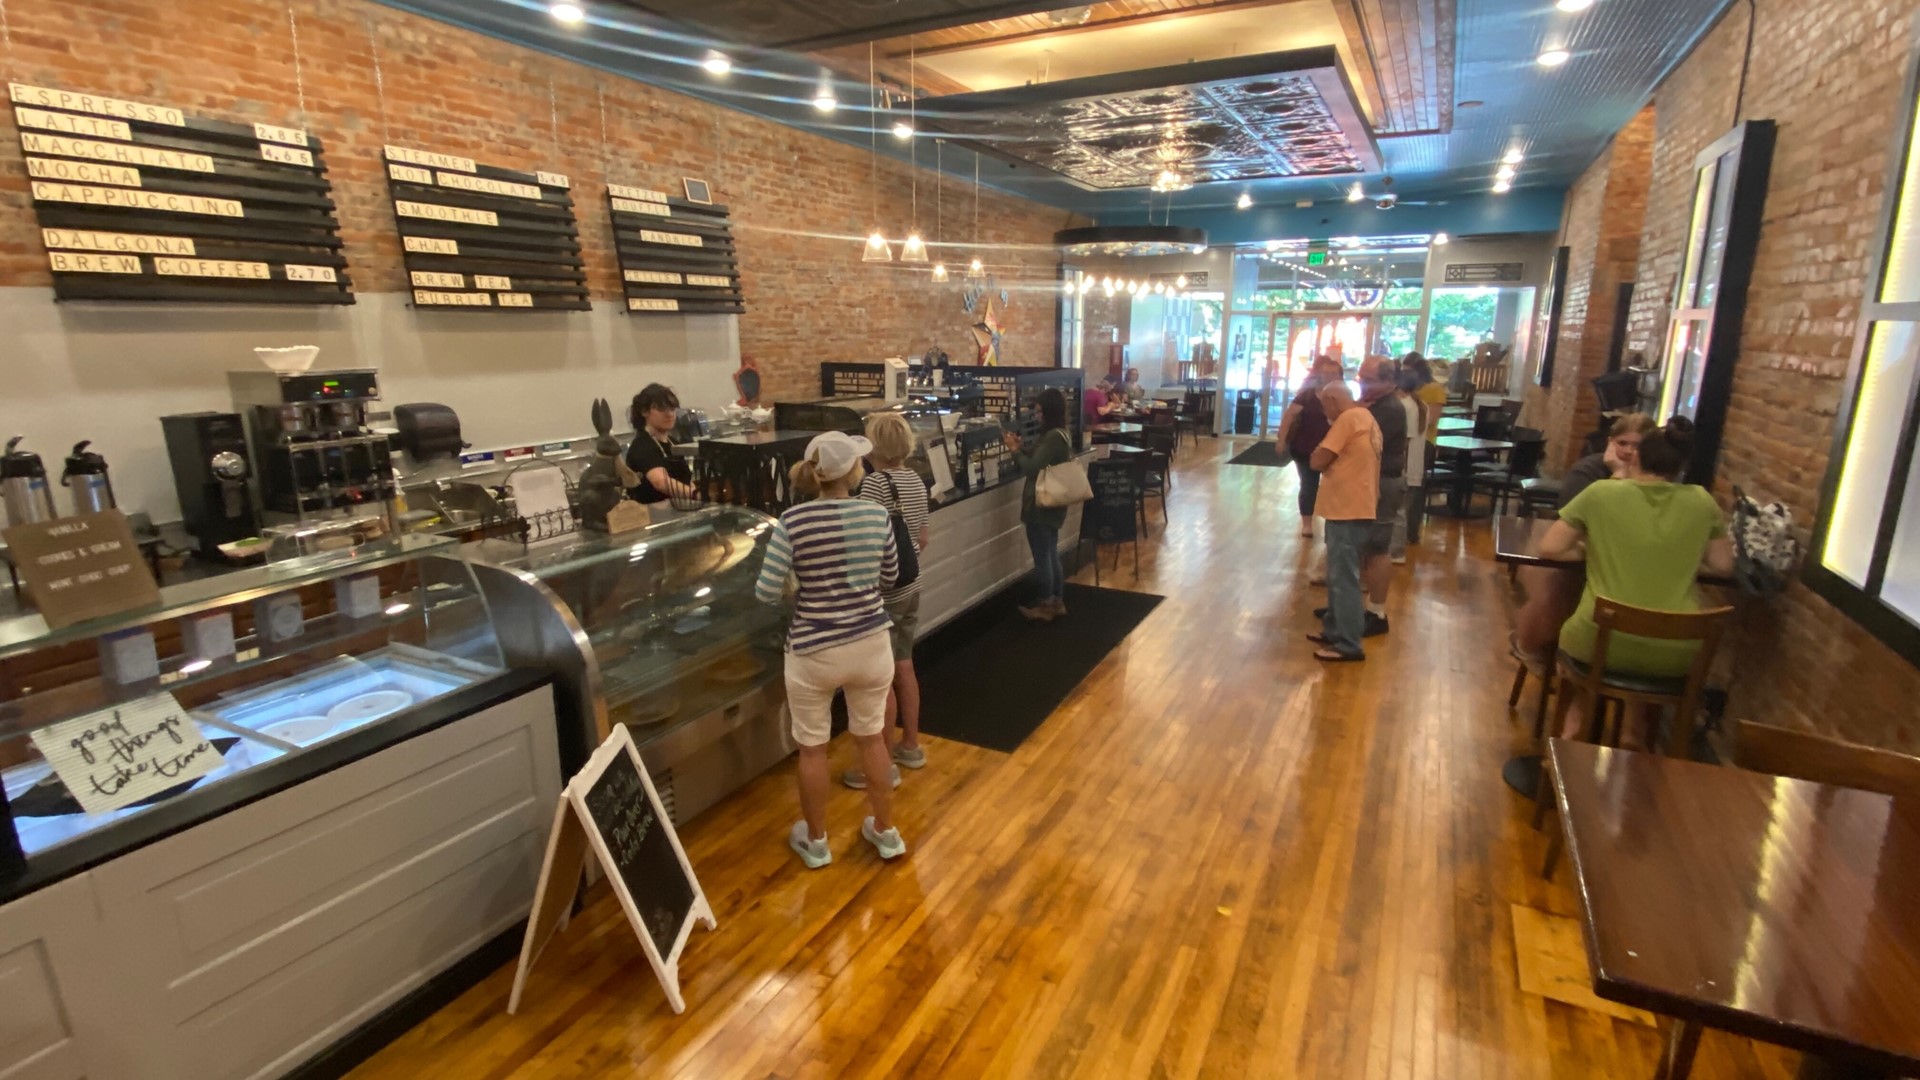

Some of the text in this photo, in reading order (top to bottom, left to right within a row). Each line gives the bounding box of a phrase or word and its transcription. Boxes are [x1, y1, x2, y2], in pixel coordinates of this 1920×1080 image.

[13, 86, 303, 144] ESPRESSO 2.85
[20, 112, 308, 164] LATTE 4.65
[24, 135, 208, 171] MACCHIATO
[388, 148, 471, 171] STEAMER
[29, 161, 135, 182] MOCHA
[392, 167, 537, 198] HOT CHOCOLATE
[36, 185, 238, 214] CAPPUCCINO
[400, 204, 494, 225] SMOOTHIE
[47, 231, 190, 253] DALGONA
[406, 238, 451, 252] CHAI
[54, 255, 331, 280] BREW COFFEE 2.70
[413, 274, 508, 288] BREW TEA
[500, 294, 530, 305] TEA
[71, 710, 130, 764] good
[107, 714, 183, 764] things
[91, 741, 210, 795] take time
